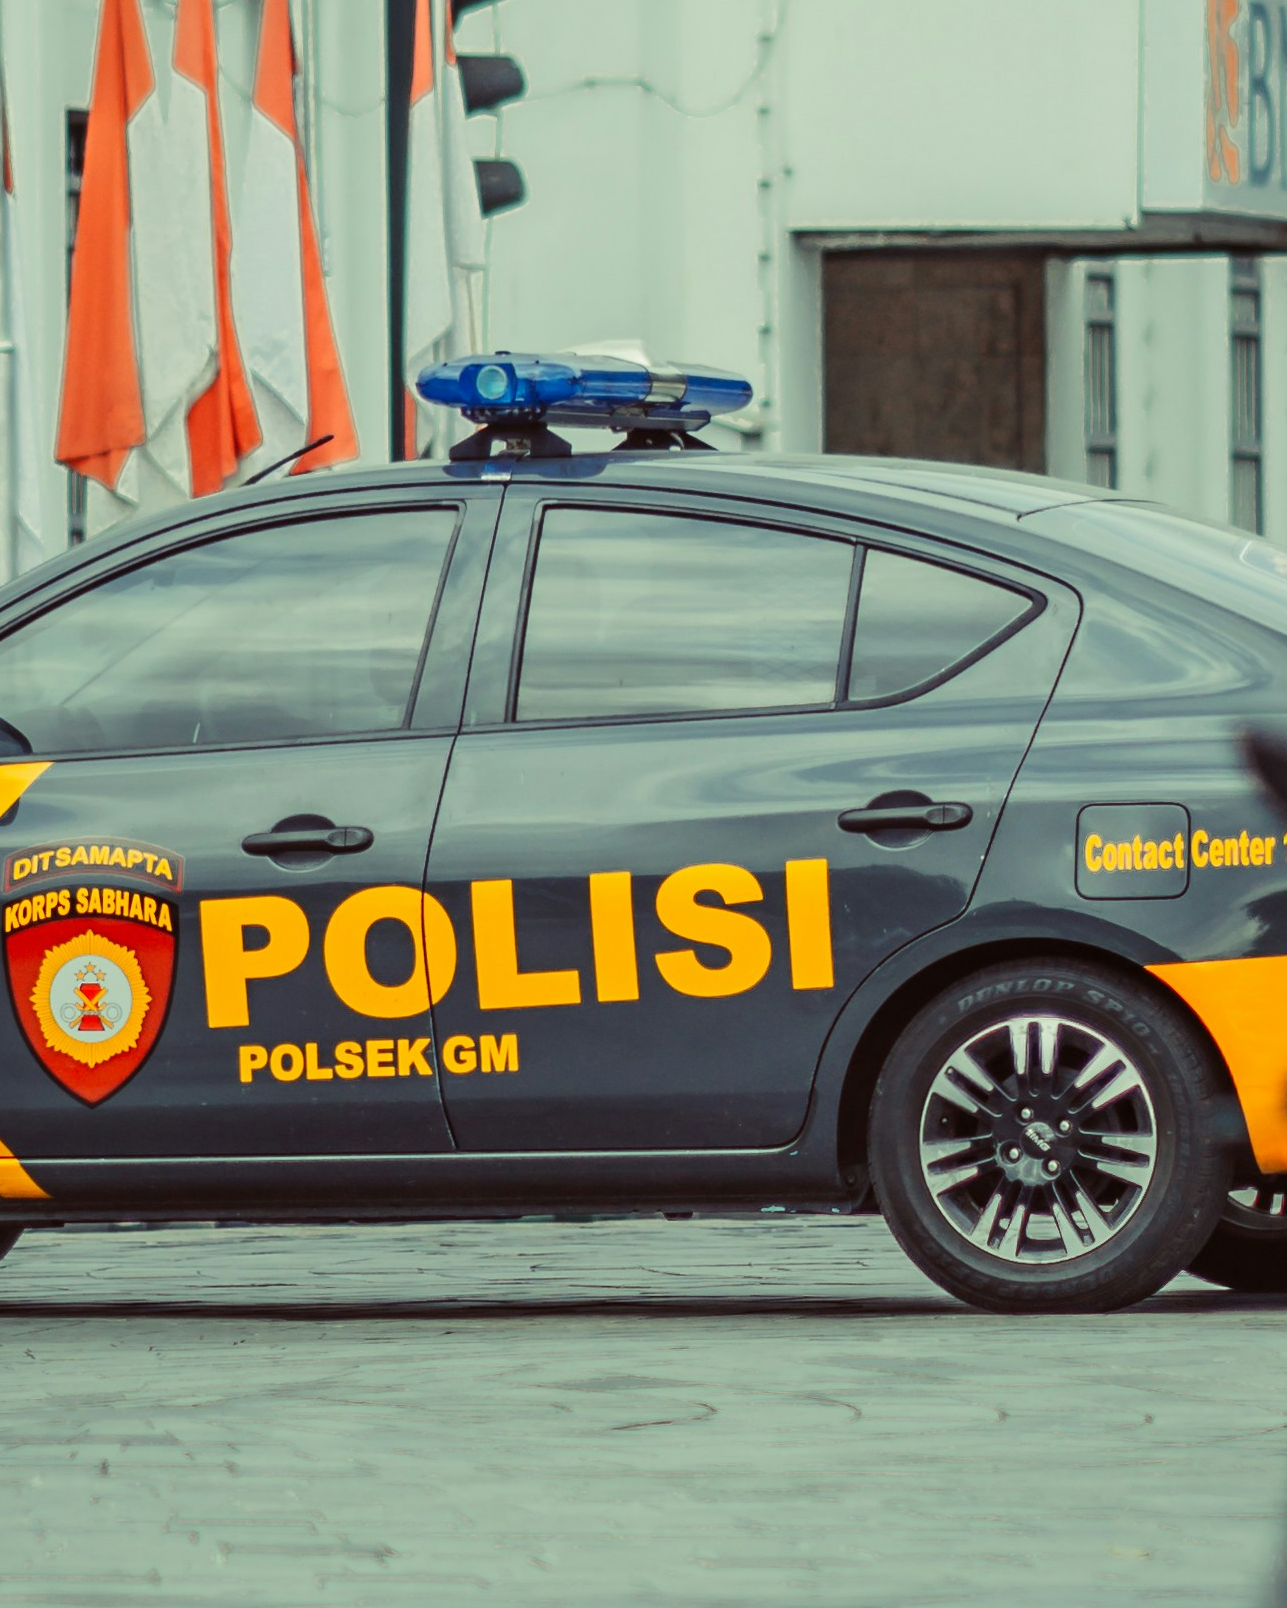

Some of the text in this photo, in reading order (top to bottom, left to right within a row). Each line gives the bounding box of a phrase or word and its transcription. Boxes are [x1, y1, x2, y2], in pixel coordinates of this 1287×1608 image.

[1084, 834, 1185, 872] Contact
[1191, 829, 1276, 868] Center
[4, 887, 173, 933] KORPS SABHARA
[199, 858, 835, 1029] POLISI
[238, 1032, 520, 1084] POLSEK GM
